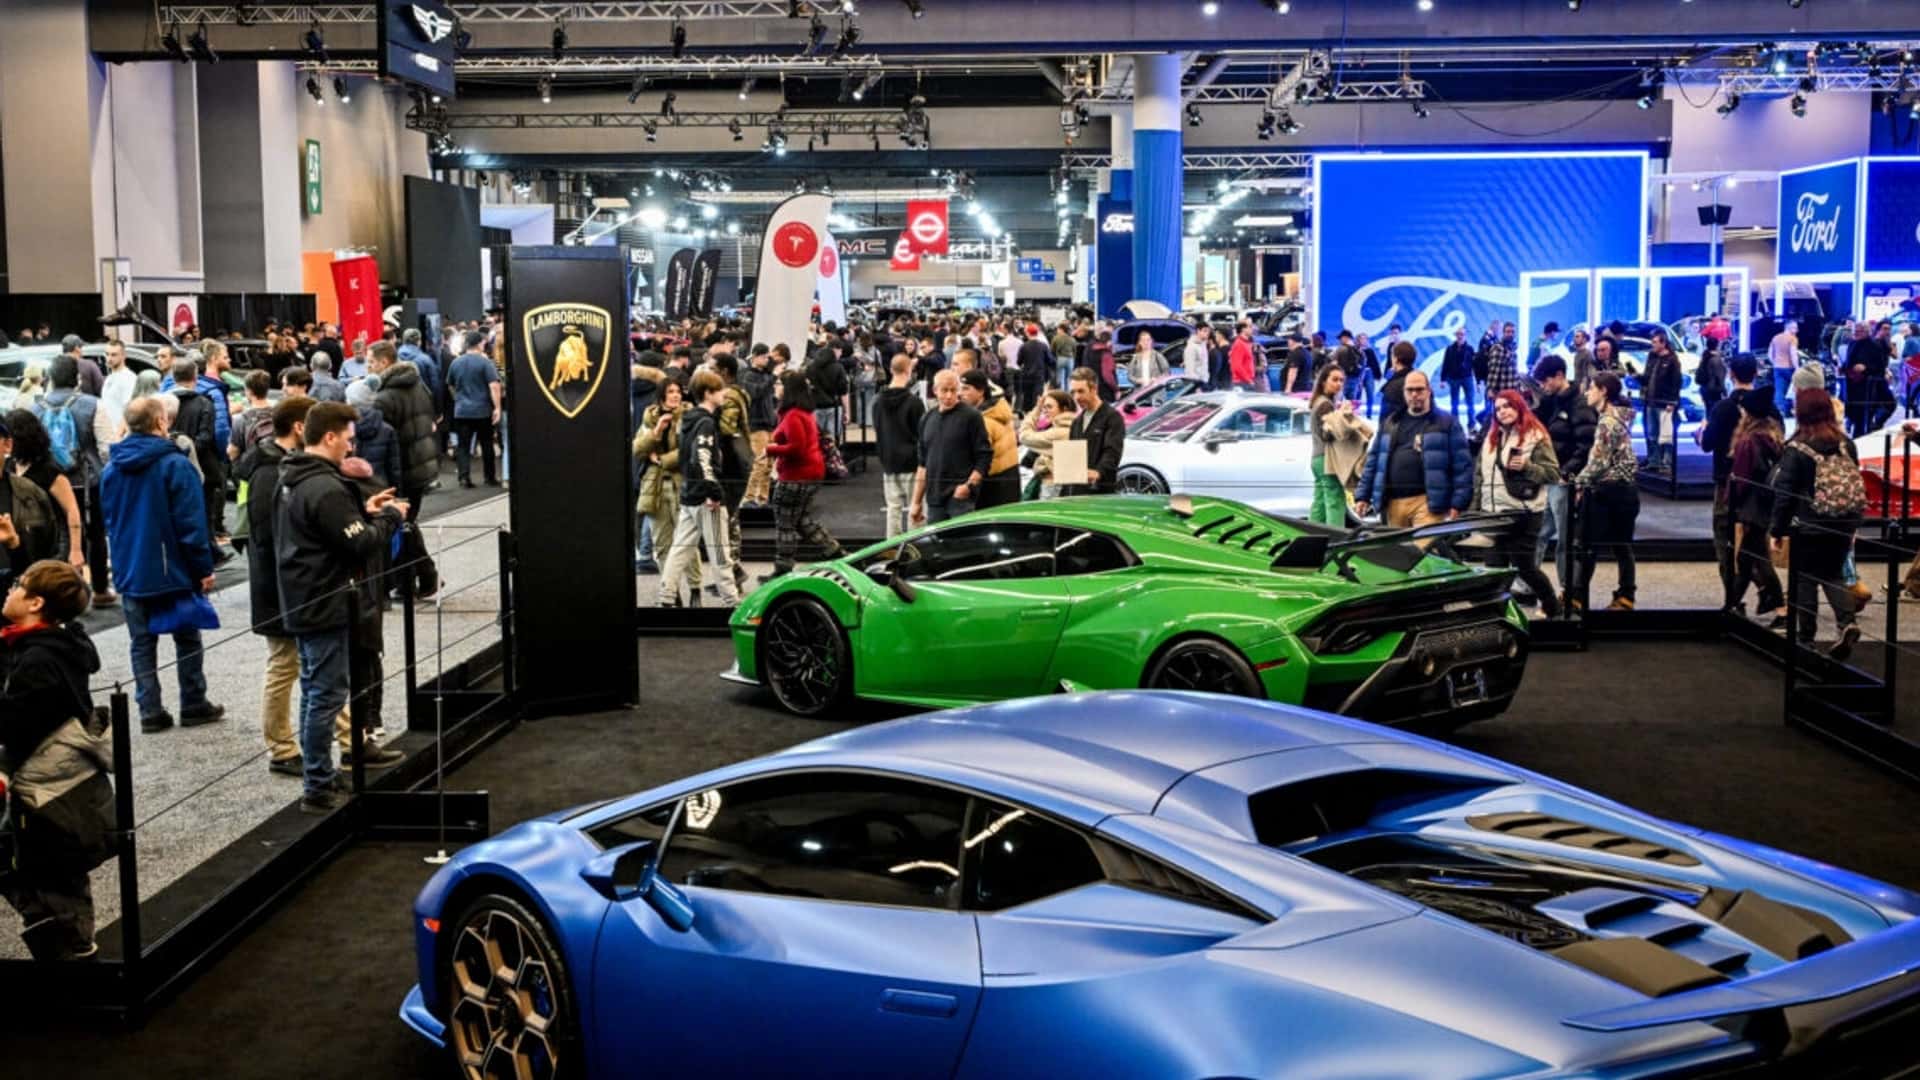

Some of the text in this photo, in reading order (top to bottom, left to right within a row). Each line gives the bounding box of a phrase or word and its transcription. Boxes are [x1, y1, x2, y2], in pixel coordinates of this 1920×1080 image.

[1101, 213, 1135, 233] For
[1791, 191, 1841, 253] Ford
[839, 238, 887, 255] MC
[531, 310, 605, 331] LAMBORGHINI
